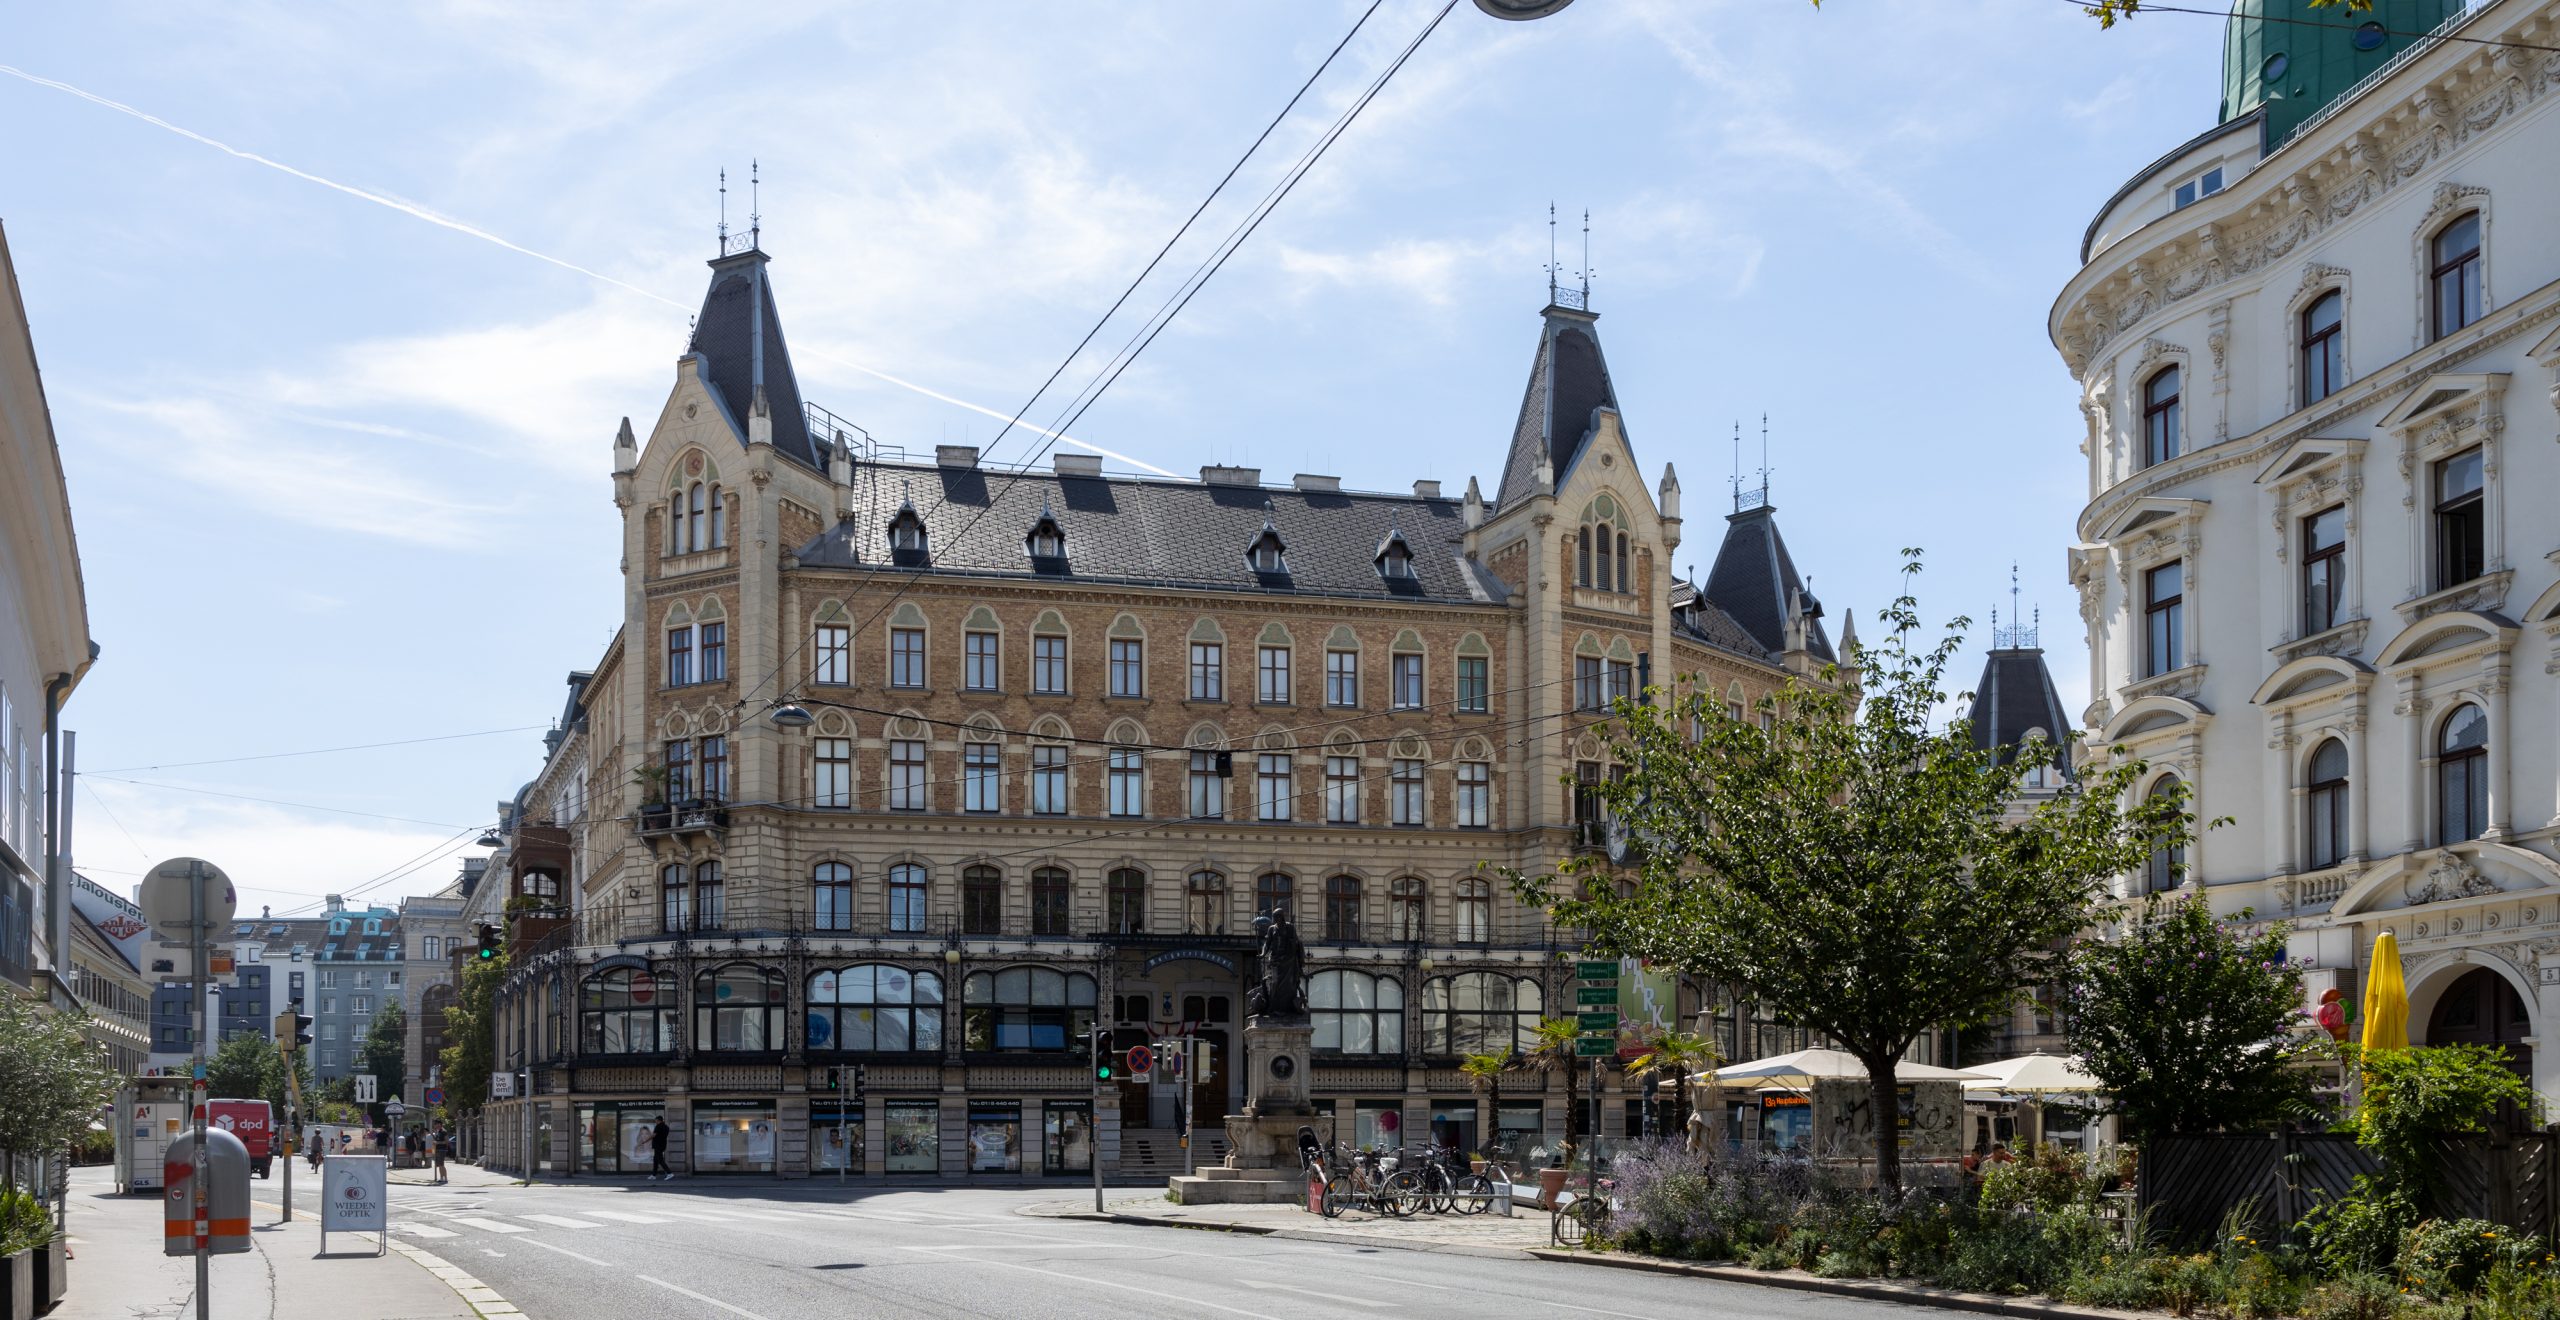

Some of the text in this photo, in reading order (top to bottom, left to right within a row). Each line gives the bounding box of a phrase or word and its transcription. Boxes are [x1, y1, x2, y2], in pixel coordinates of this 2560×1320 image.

[76, 875, 147, 923] jalousien
[2547, 969, 2553, 980] 5
[147, 1067, 159, 1077] A1
[136, 1106, 151, 1119] A1
[240, 1118, 263, 1131] dpd
[335, 1201, 376, 1210] WIEDEN
[339, 1210, 371, 1218] OPTIK
